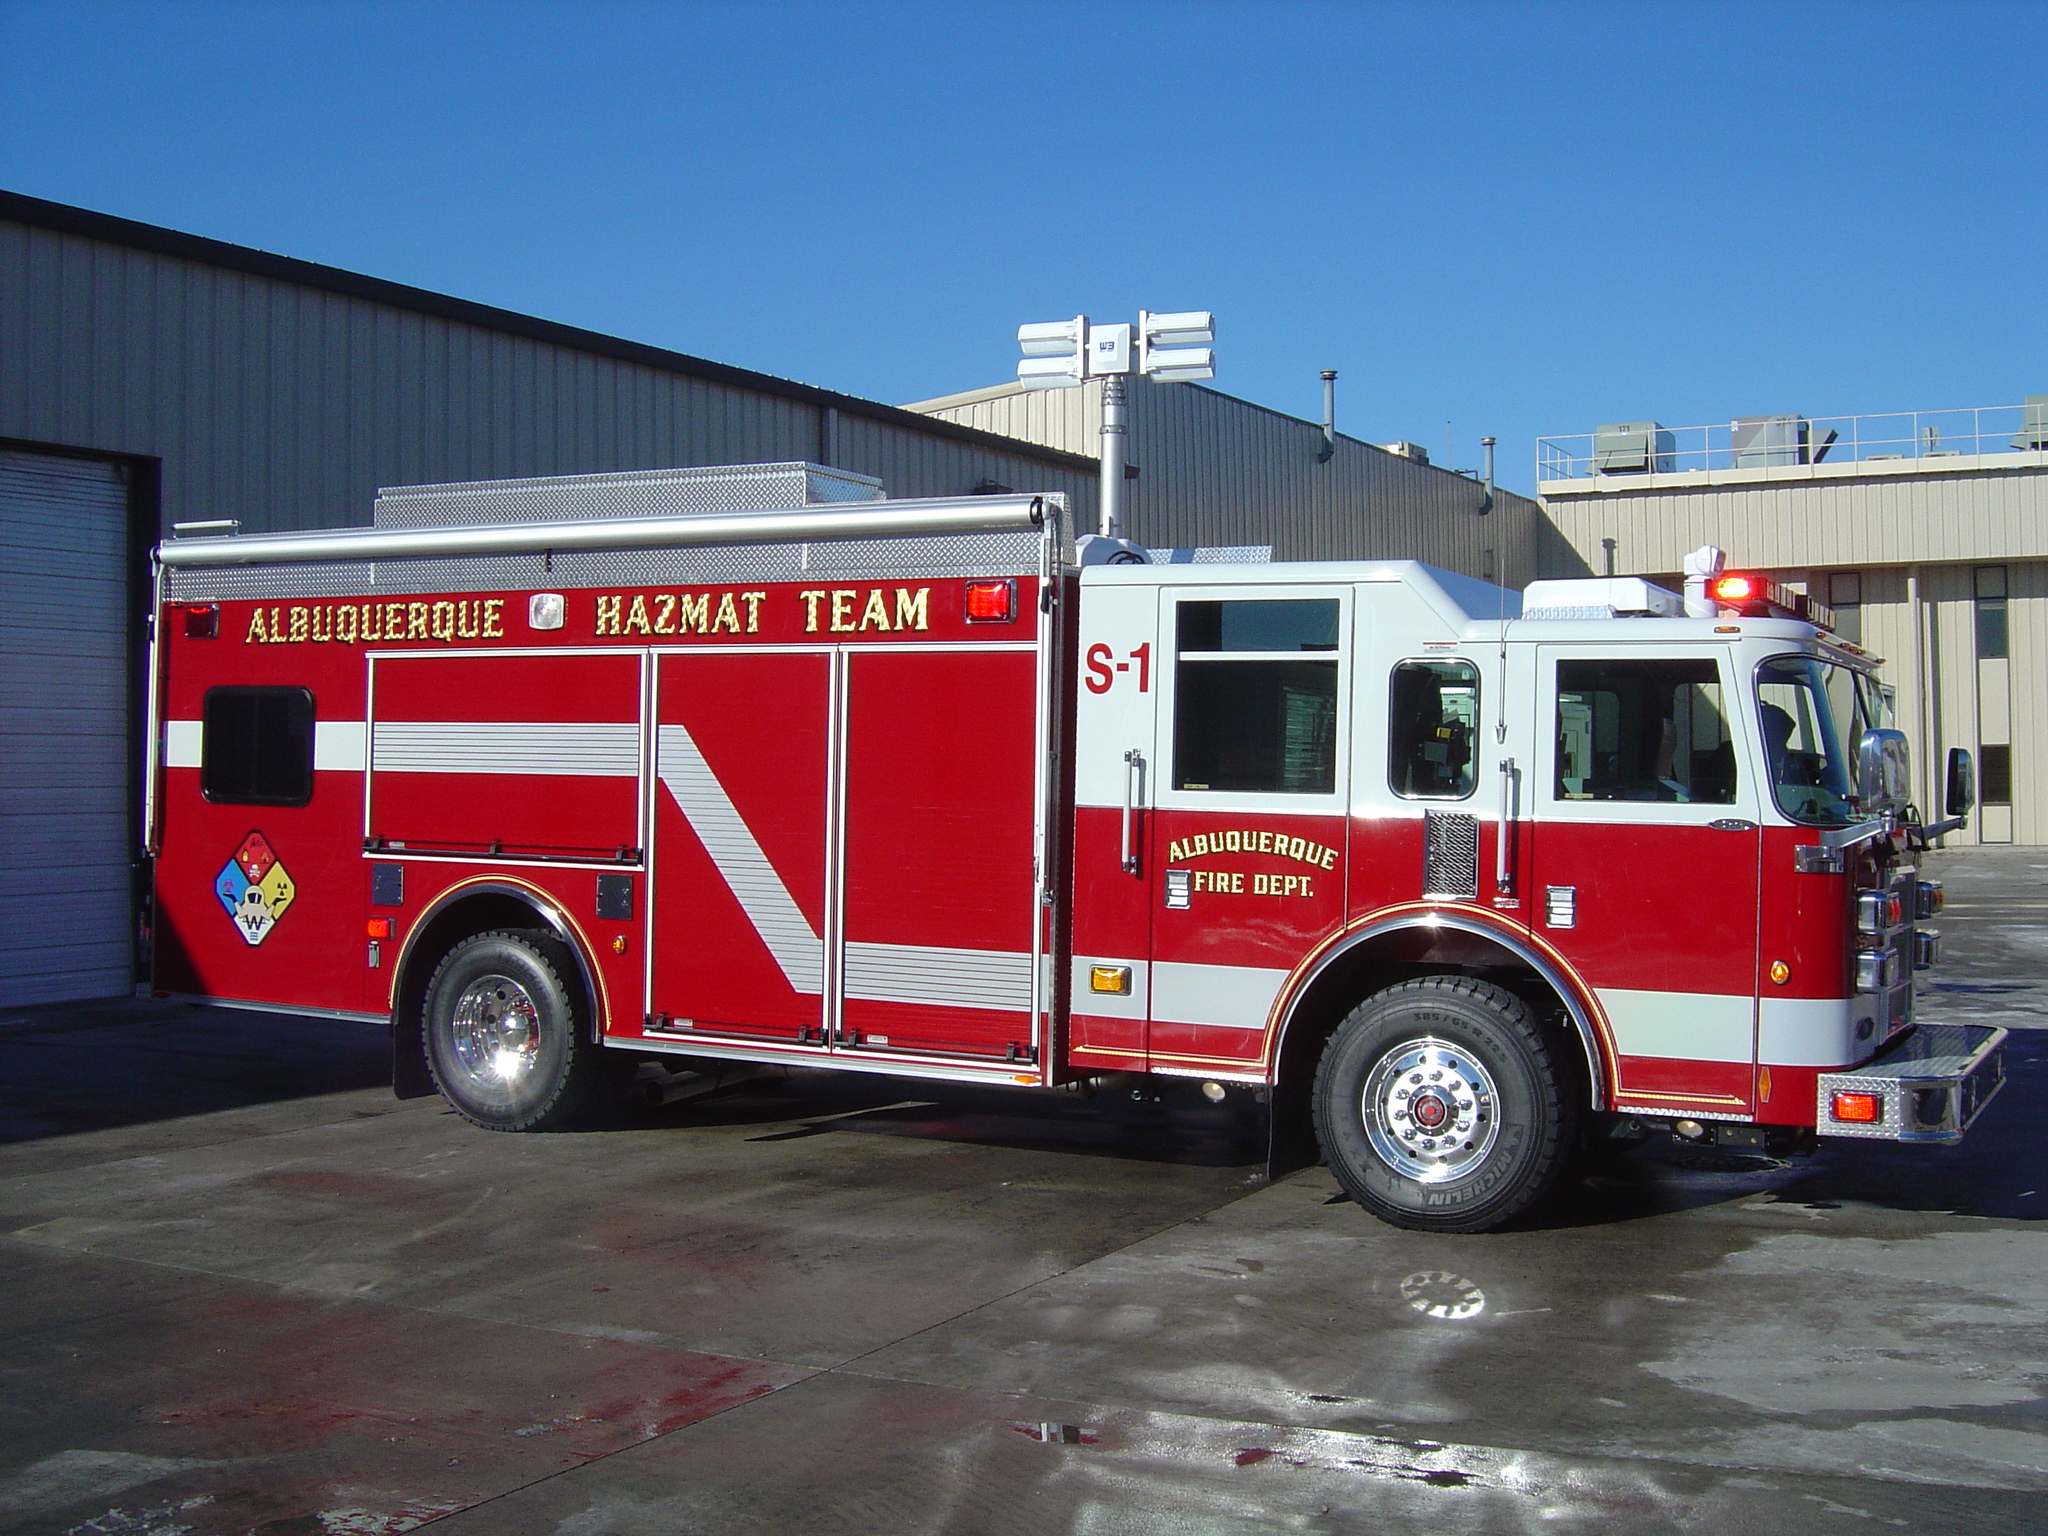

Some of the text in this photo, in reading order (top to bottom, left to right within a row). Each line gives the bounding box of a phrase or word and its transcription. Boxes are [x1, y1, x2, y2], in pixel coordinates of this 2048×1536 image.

[245, 587, 931, 645] ALBUQUERQUE HAZMAT TEAM
[1085, 642, 1150, 694] S-1
[1169, 830, 1339, 870] ALBUQUERQUE
[1194, 871, 1315, 898] FIRE DEPT.
[1428, 1150, 1514, 1206] MICHELIN
